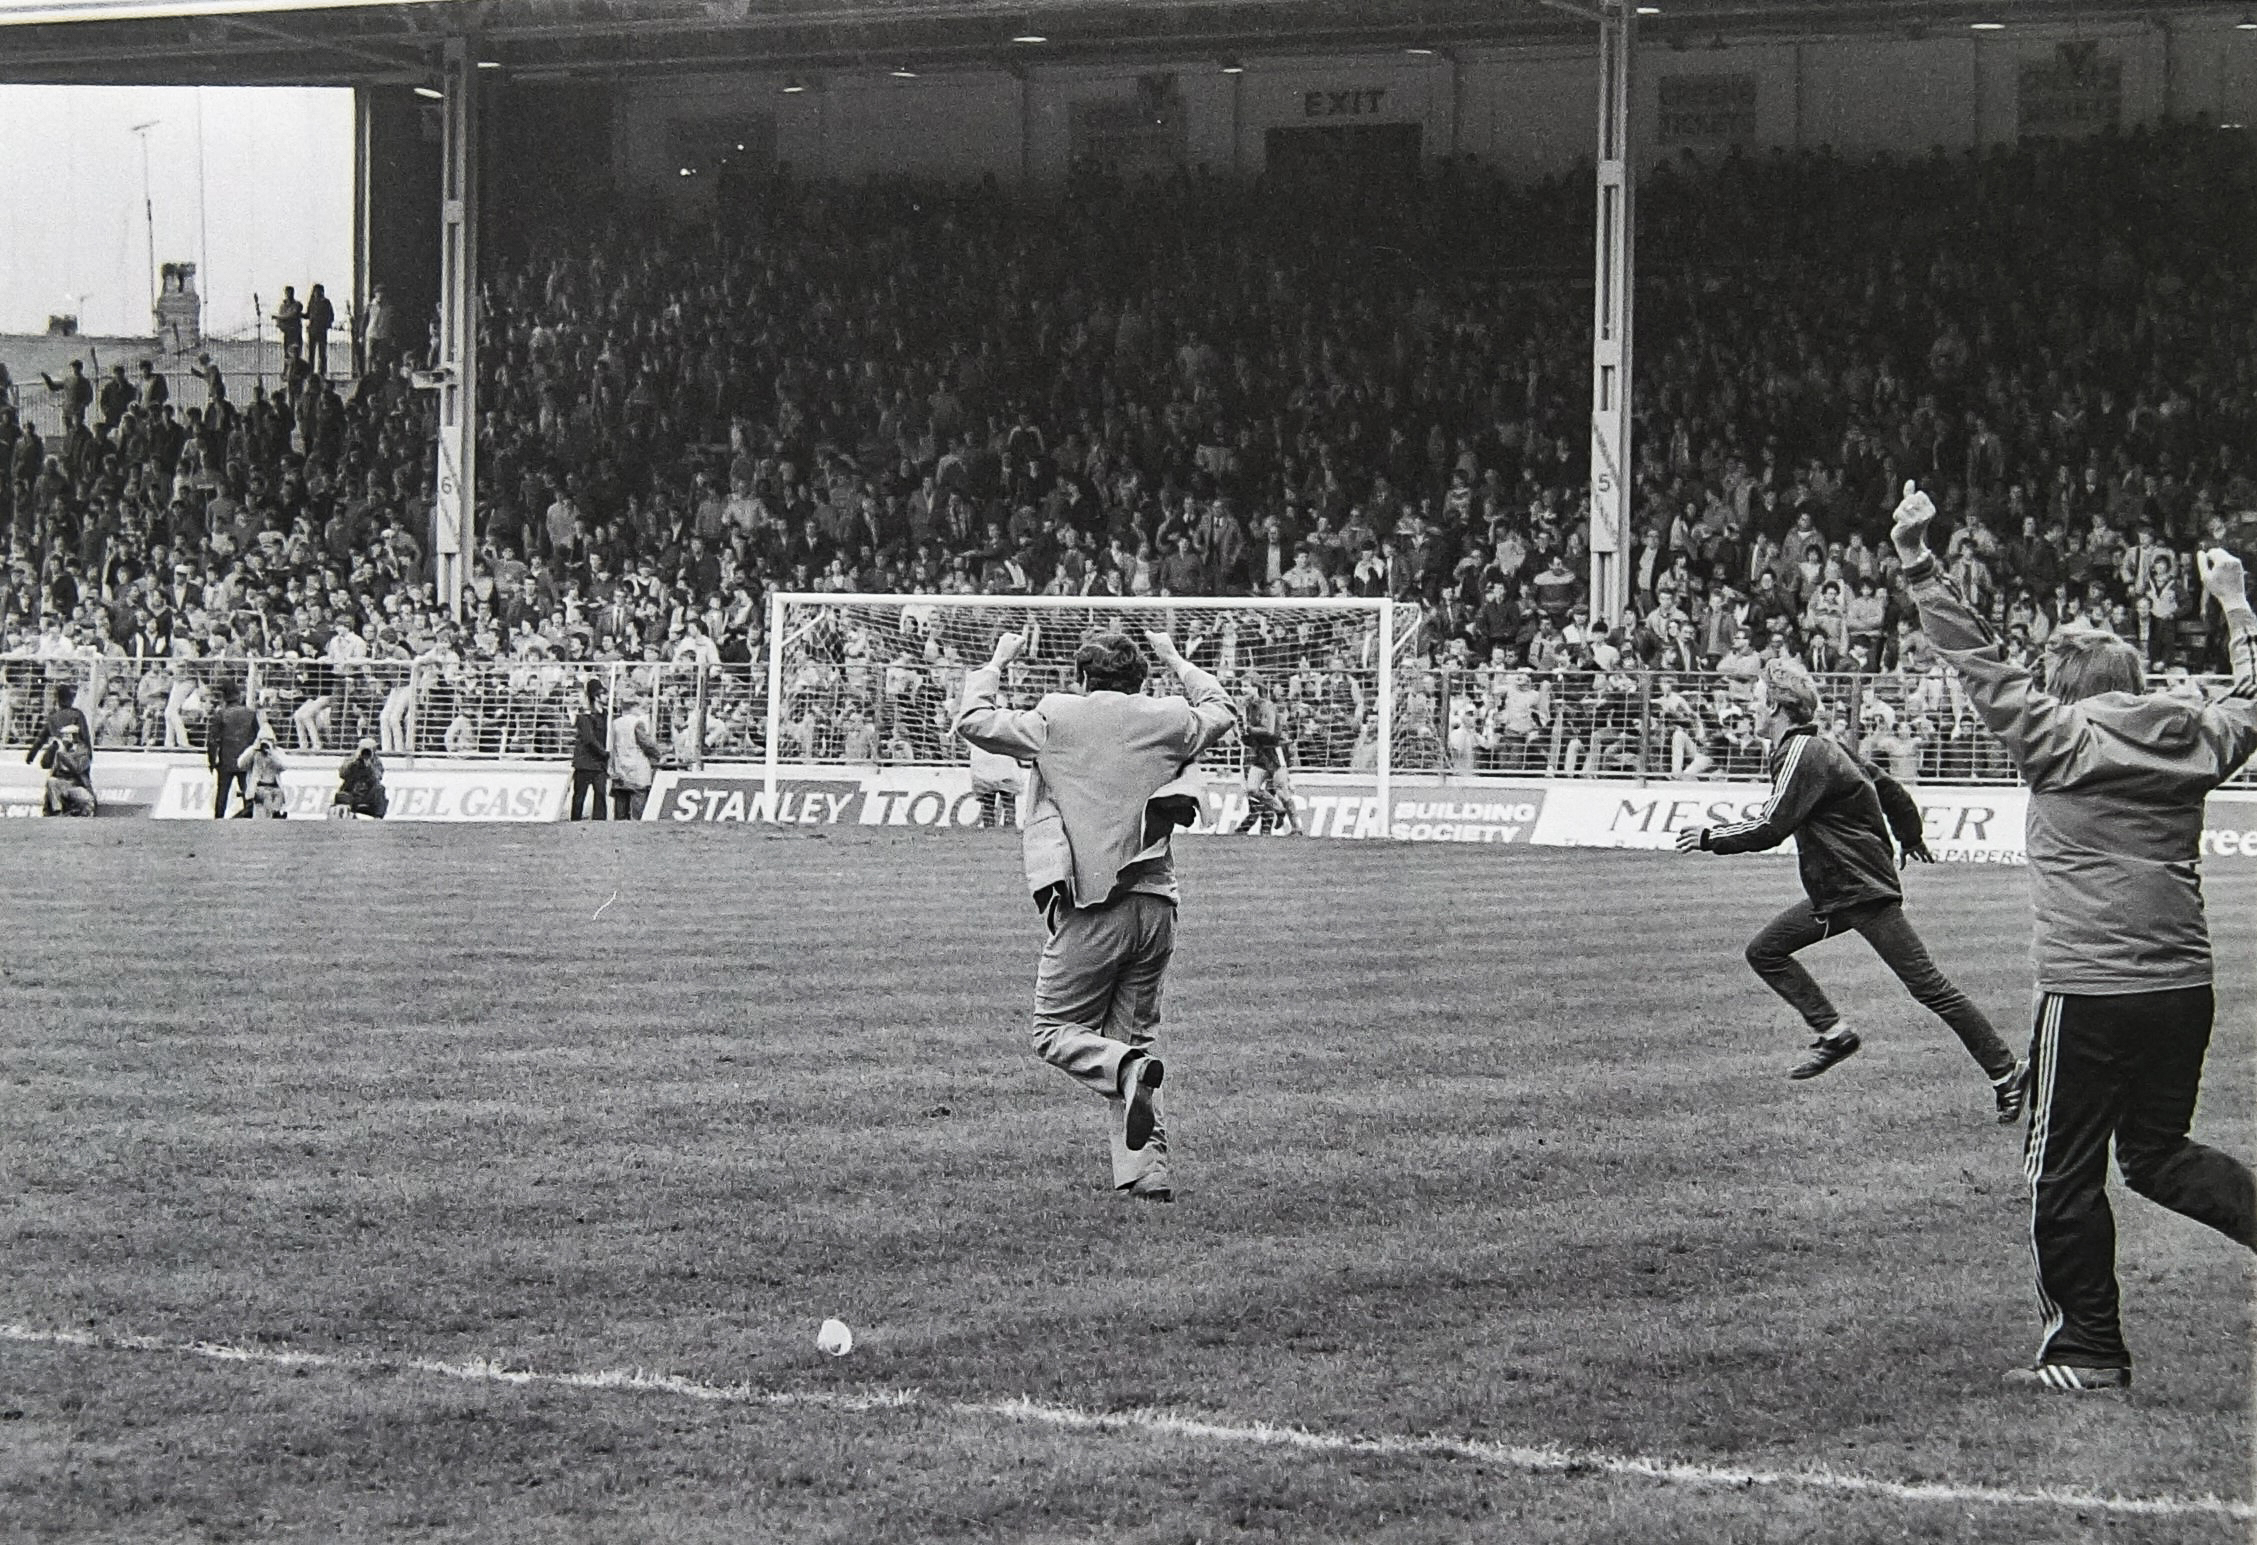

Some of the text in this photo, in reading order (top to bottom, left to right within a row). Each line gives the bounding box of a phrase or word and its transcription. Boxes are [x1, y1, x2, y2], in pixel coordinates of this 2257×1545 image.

[1304, 89, 1385, 117] EXIT
[441, 475, 452, 495] 6
[1598, 473, 1611, 493] 5
[460, 785, 548, 817] GAS!
[672, 788, 855, 825] STANLEY
[1394, 802, 1536, 822] BUILDING
[1390, 823, 1521, 843] SOCIETY
